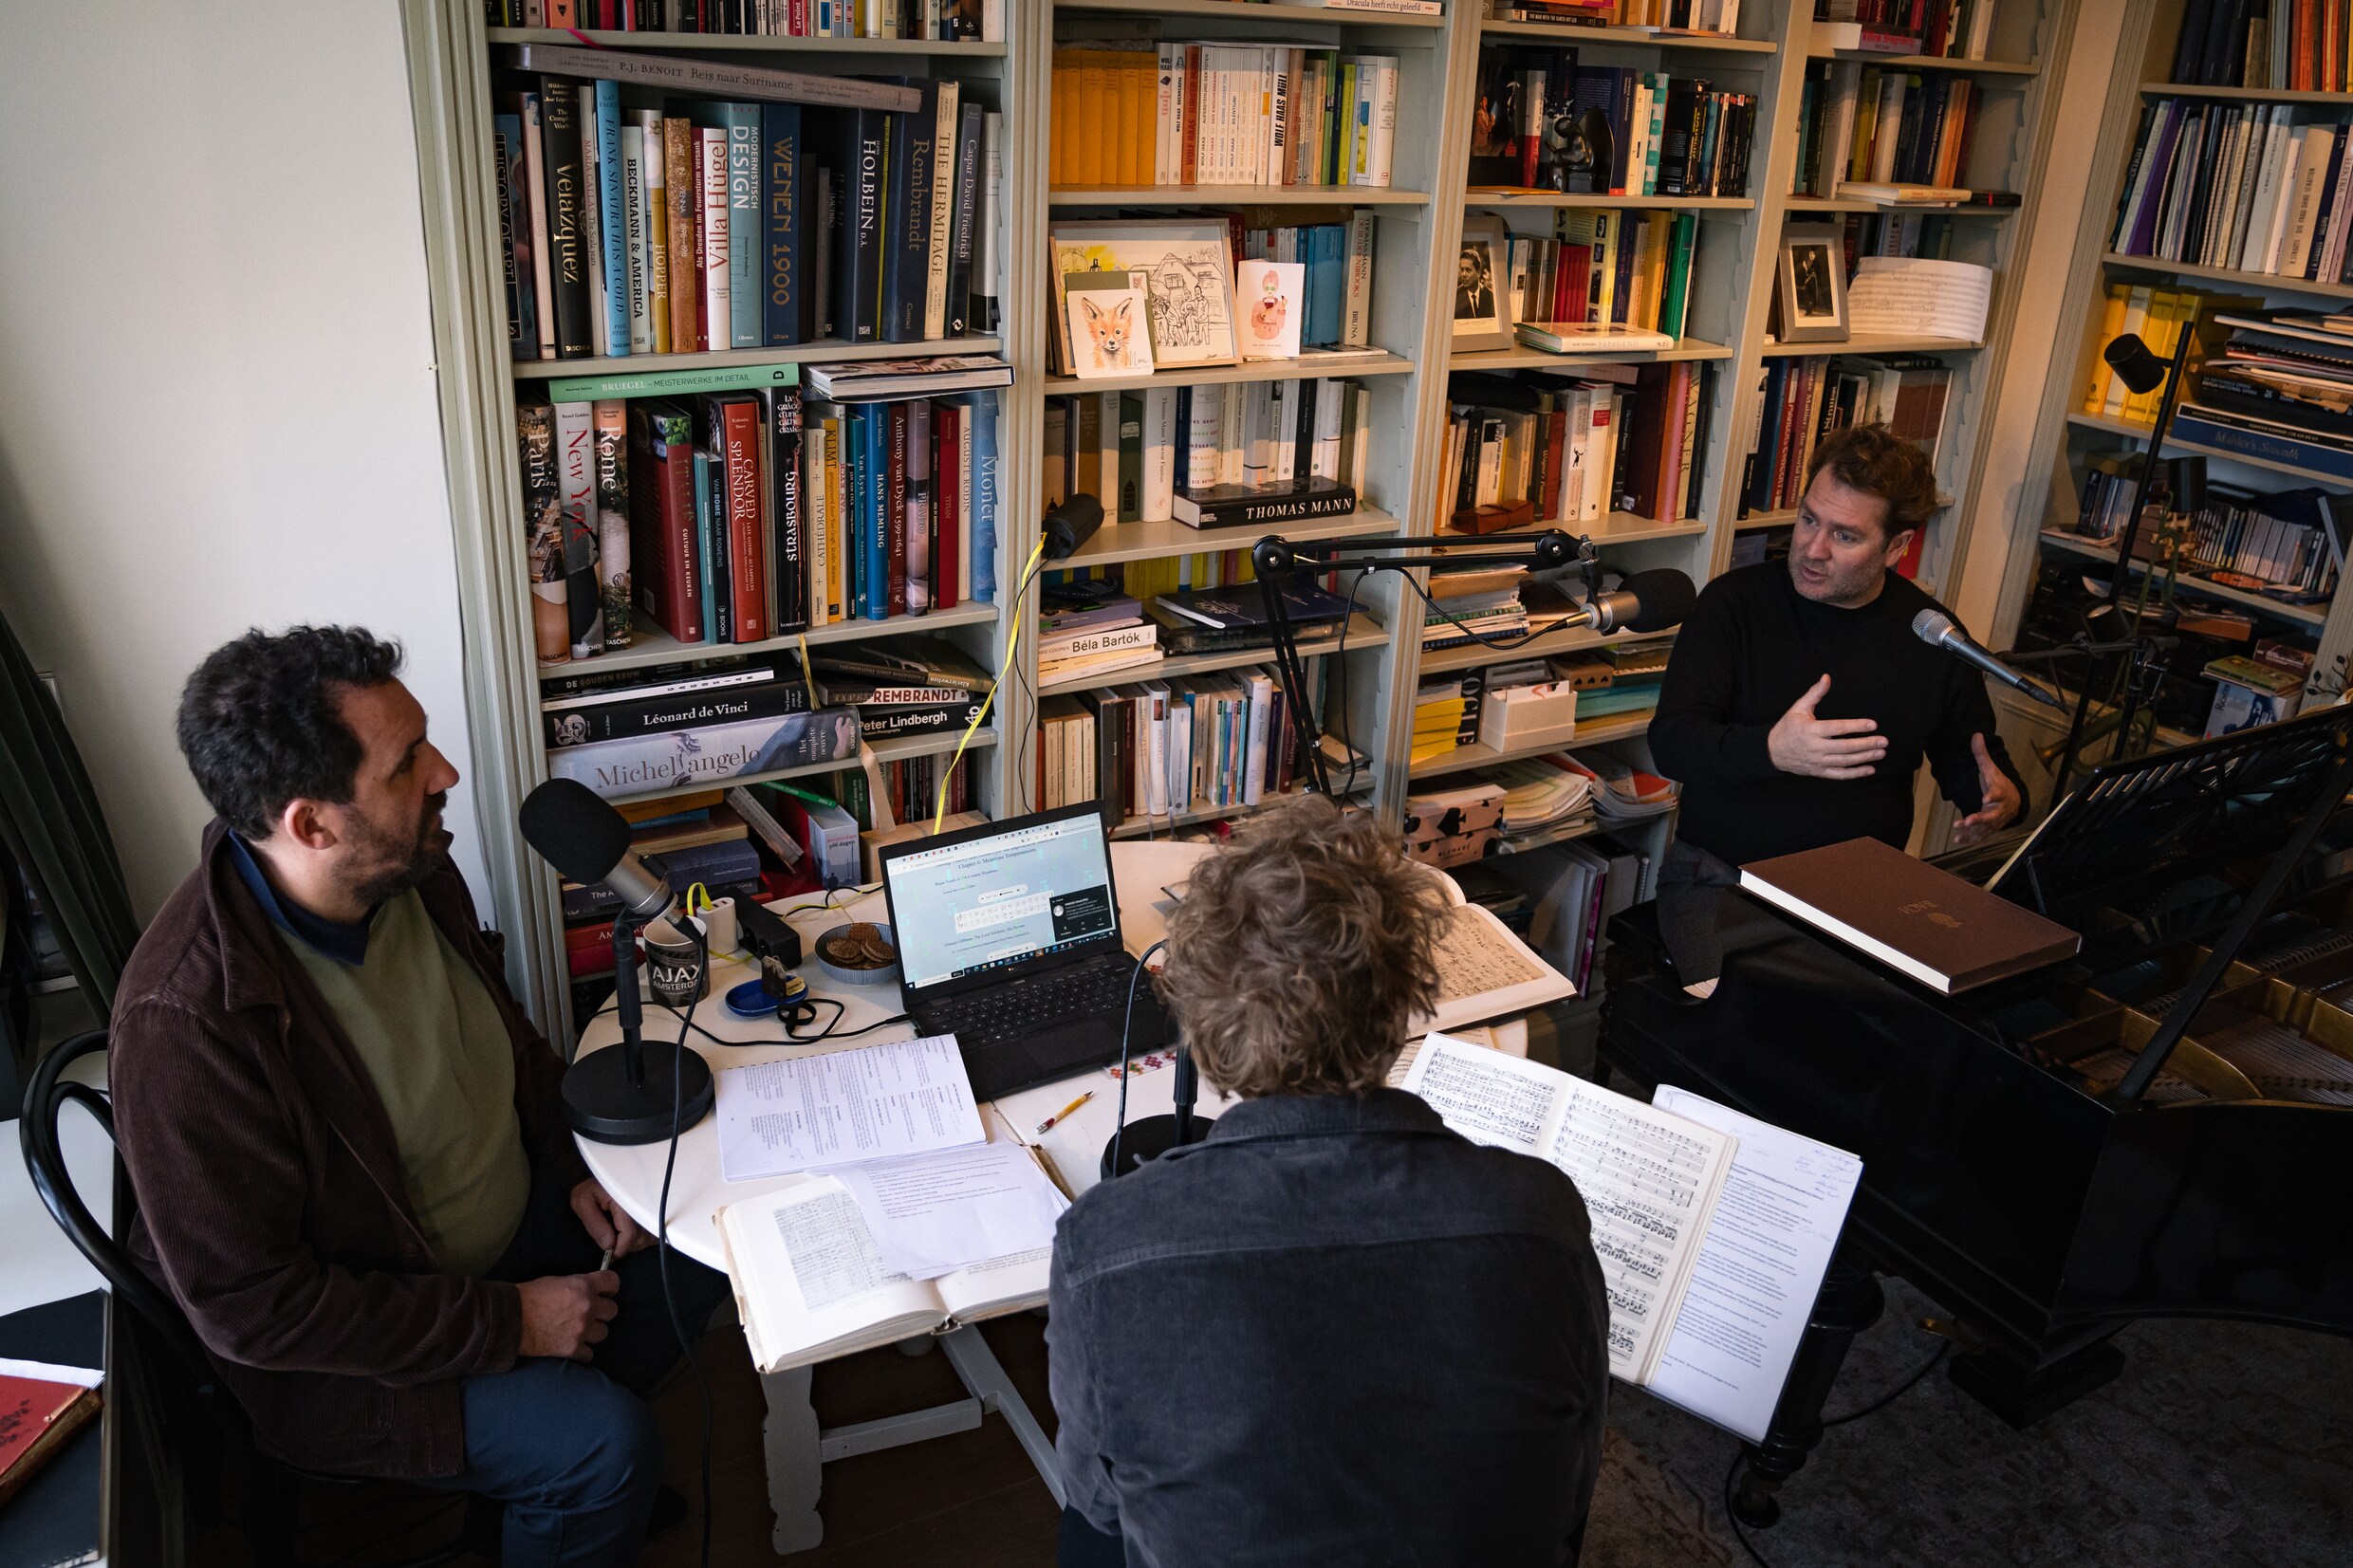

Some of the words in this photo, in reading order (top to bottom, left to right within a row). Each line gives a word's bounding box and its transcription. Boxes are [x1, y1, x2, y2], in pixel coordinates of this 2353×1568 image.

[620, 63, 638, 73] P.J.
[641, 65, 684, 77] BENOIT
[691, 67, 714, 81] Reis
[716, 72, 741, 83] naar
[742, 73, 794, 90] Suriname
[1277, 74, 1288, 98] MÜLL
[1276, 99, 1287, 122] HAAS
[605, 119, 617, 165] FRANK
[937, 133, 951, 169] THE
[1274, 124, 1285, 147] WOLF
[707, 138, 728, 212] Hügel
[732, 125, 750, 210] DESIGN
[750, 125, 759, 210] MODERNISTISCH
[964, 139, 977, 175] Caspar
[607, 170, 620, 230] SINATRA
[627, 158, 640, 239] BECKMANN
[678, 186, 687, 214] VIENNA
[695, 170, 703, 213] Feuersturm
[772, 136, 793, 233] WENEN
[861, 138, 878, 231] HOLBEIN
[908, 138, 930, 251] Rembrandt
[962, 178, 974, 211] David
[553, 163, 580, 284] Velazquez
[695, 224, 704, 253] Dresden
[709, 214, 729, 272] Villa
[931, 176, 949, 277] HERMITAGE
[959, 212, 973, 259] Friedrich
[611, 233, 621, 262] HAS
[630, 241, 641, 252] &
[695, 253, 704, 269] Als
[630, 255, 644, 320] AMERICA
[656, 244, 668, 300] HOPPER
[772, 244, 792, 305] 1900
[613, 274, 624, 314] COLD
[1350, 310, 1360, 339] BRUNA
[602, 381, 647, 392] BRUEGEL
[654, 376, 713, 388] MEISTERWERKE
[725, 373, 751, 383] DETAIL
[896, 415, 905, 462] Anthony
[1679, 377, 1700, 473] WAGNER
[528, 431, 549, 489] Paris
[566, 427, 590, 482] New
[600, 425, 622, 491] Rome
[825, 430, 837, 469] KLIMT
[730, 440, 747, 522] SPLENDOR
[742, 458, 758, 519] CARVED
[896, 485, 905, 512] Dyck
[981, 454, 999, 523] Monet
[713, 493, 722, 516] ROME
[1246, 502, 1306, 520] THOMAS
[1310, 497, 1353, 512] MANN
[816, 494, 826, 567] CATHÉDRALE
[685, 560, 691, 569] EN
[577, 643, 602, 653] TASCHEN
[605, 636, 631, 646] TASCHEN
[1072, 639, 1099, 653] Béla
[1102, 631, 1141, 648] Bartók
[565, 680, 578, 689] DE
[873, 689, 958, 703] REMBRANDT
[930, 675, 971, 688] Klavierwelten
[643, 706, 696, 727] Léonard
[698, 707, 713, 717] de
[714, 701, 749, 715] Vinci
[858, 719, 887, 731] Peter
[889, 711, 948, 729] Lindbergh
[594, 756, 678, 789] Michel
[687, 745, 761, 775] angelo
[958, 861, 976, 870] Chapter
[653, 964, 701, 984] AJAX
